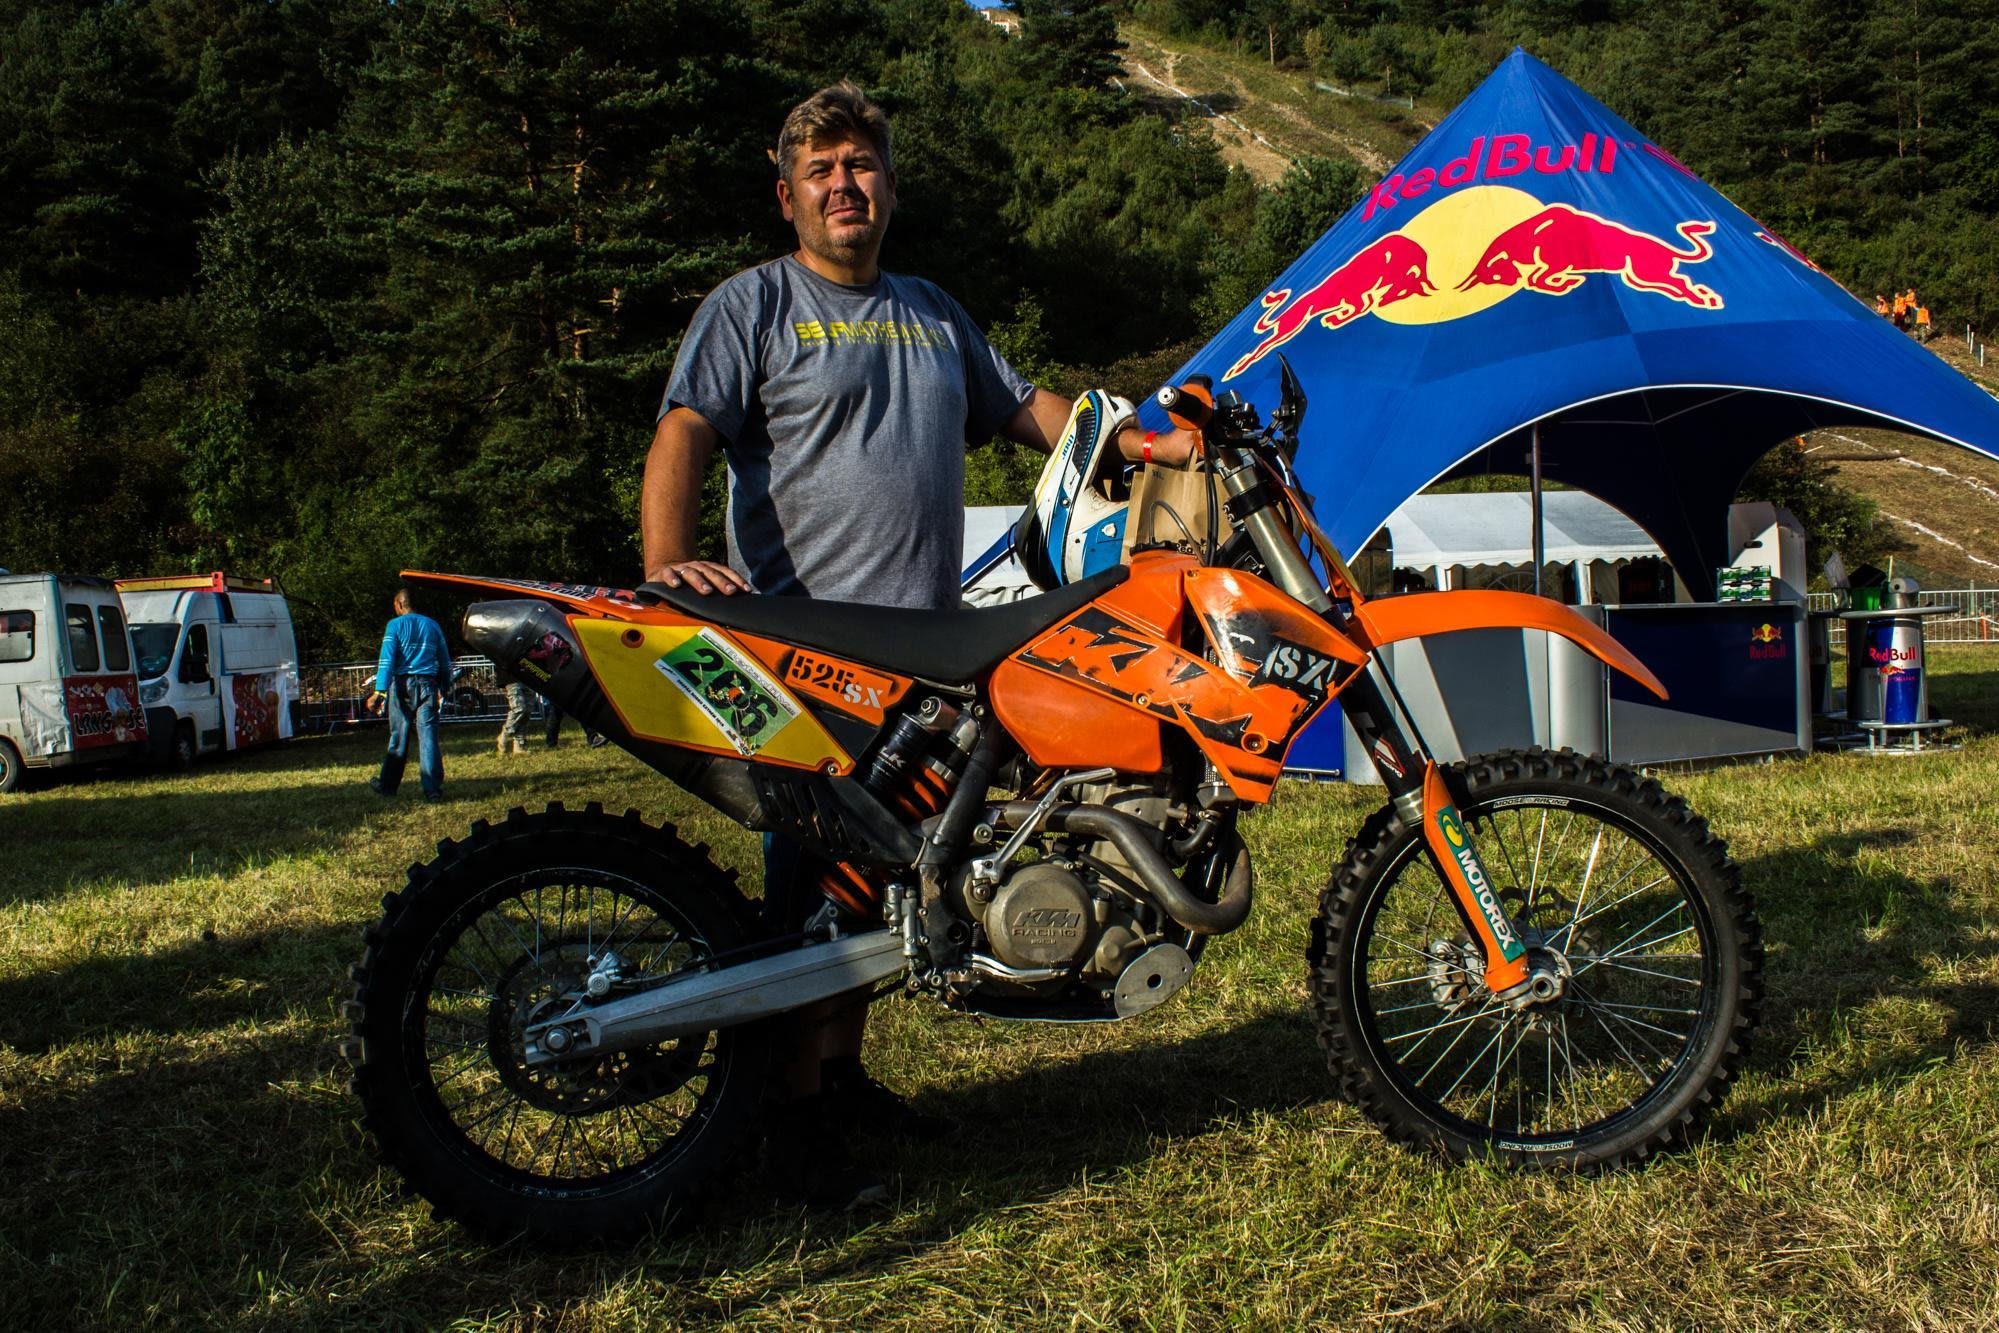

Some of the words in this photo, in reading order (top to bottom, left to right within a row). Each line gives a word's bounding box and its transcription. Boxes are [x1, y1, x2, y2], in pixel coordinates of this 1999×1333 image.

[792, 654, 854, 696] 525
[843, 681, 883, 709] SX
[1273, 646, 1331, 691] SX
[1013, 908, 1081, 928] KTM
[1458, 847, 1515, 951] MOTOREX
[1011, 928, 1076, 937] RACING
